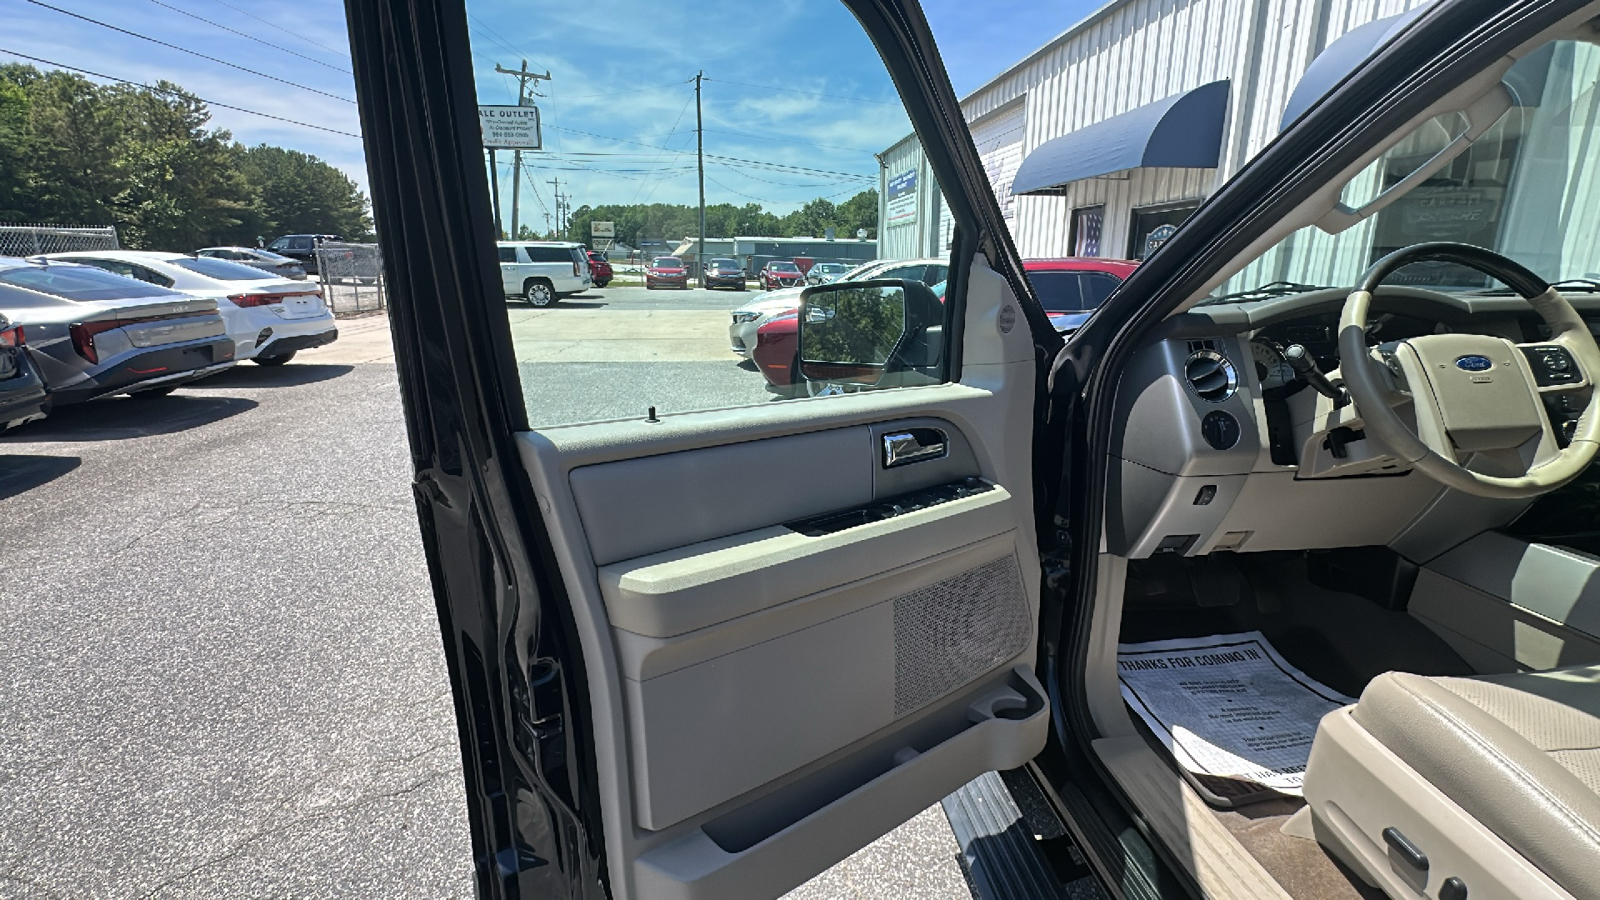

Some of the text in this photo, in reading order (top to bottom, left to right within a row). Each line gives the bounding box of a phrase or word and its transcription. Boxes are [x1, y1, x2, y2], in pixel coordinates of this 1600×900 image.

[500, 110, 535, 118] OUTLET
[1464, 359, 1486, 368] Ford
[1120, 648, 1261, 671] THANKS FOR COMING IN
